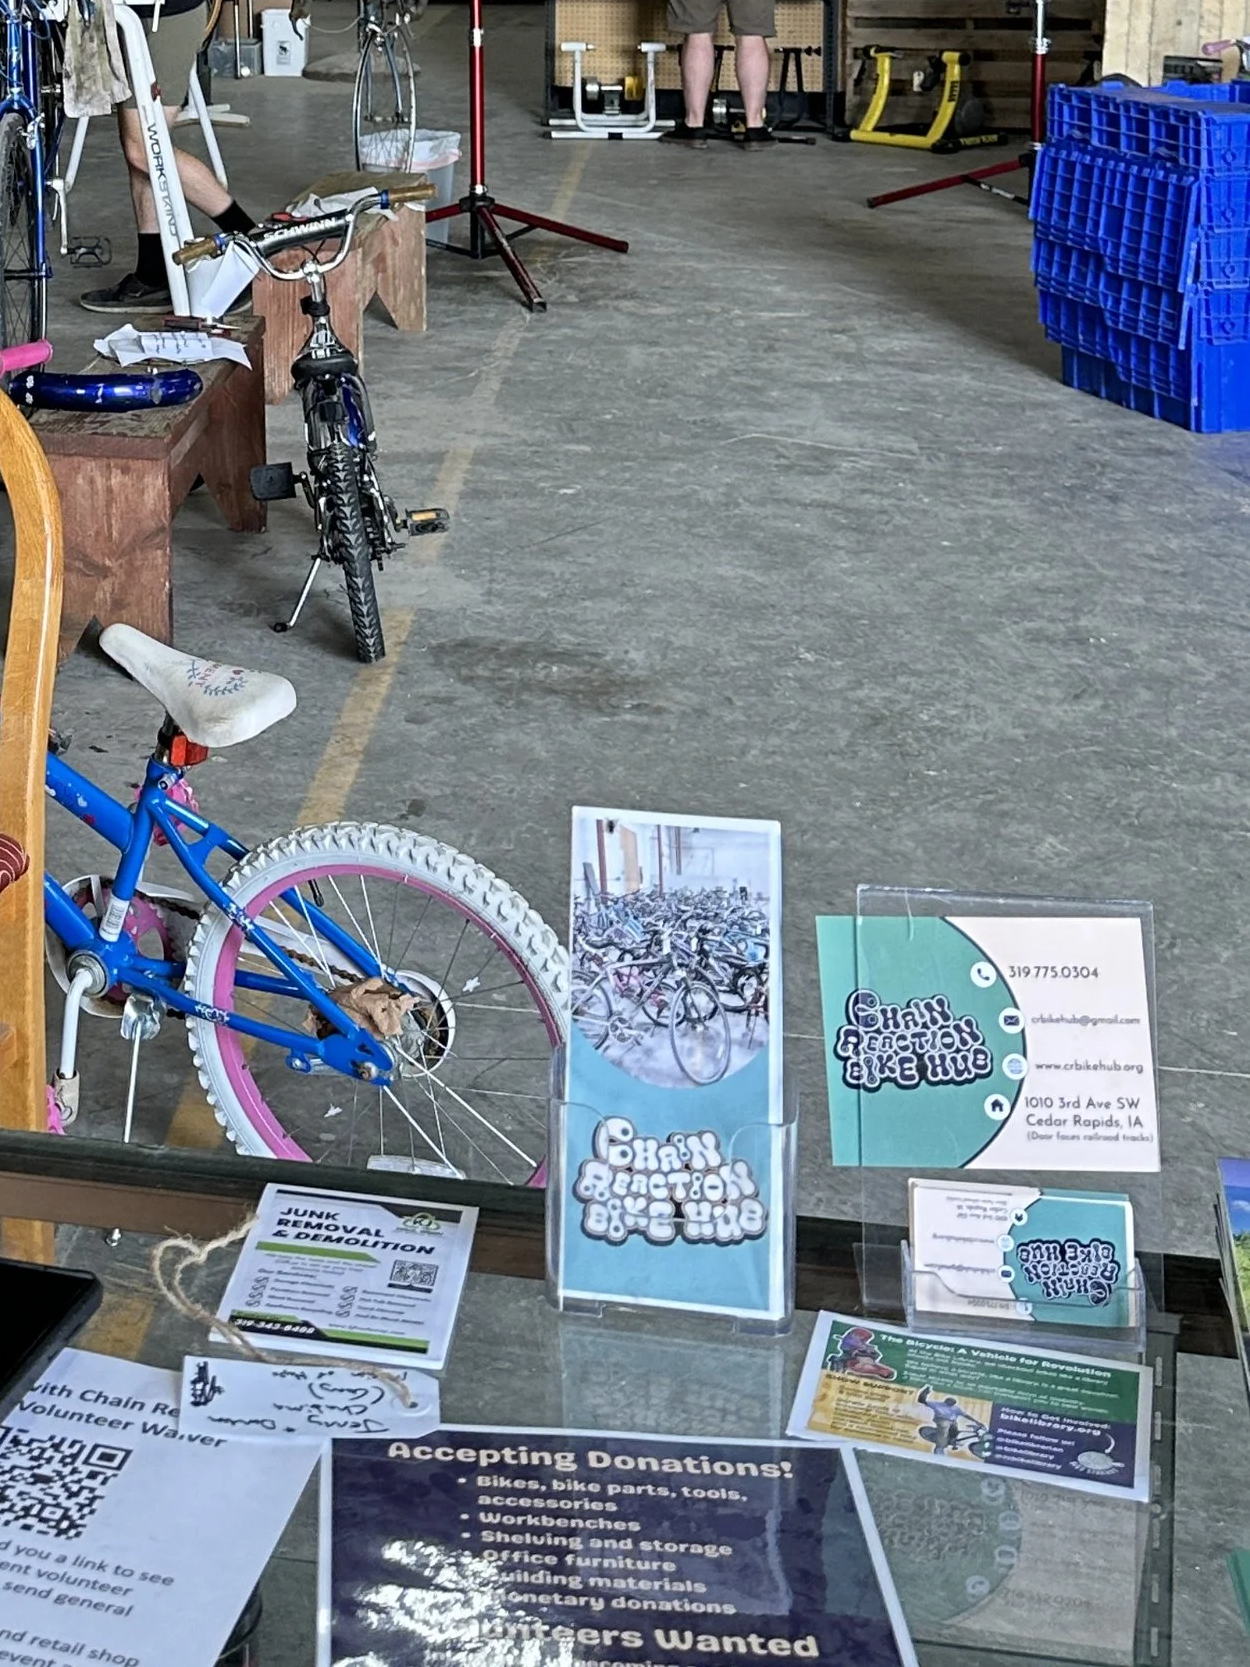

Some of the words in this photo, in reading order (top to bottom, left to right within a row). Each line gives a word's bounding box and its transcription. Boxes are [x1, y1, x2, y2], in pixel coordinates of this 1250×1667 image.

[264, 217, 337, 240] SCHWINN
[847, 989, 954, 1032] CHAIN
[836, 1016, 984, 1058] REACTION
[845, 1052, 919, 1088] BIKE
[924, 1046, 992, 1081] HUB
[1035, 1058, 1144, 1074] www.crbikehub.org
[1024, 1096, 1054, 1109] 1010
[1058, 1096, 1081, 1109] 3rd
[1085, 1096, 1112, 1110] Ave
[1116, 1096, 1141, 1110] SW
[1026, 1114, 1068, 1127] Cedar
[1073, 1114, 1123, 1130] Rapids,
[1128, 1115, 1144, 1128] IA
[279, 1206, 341, 1222] JUNK
[276, 1218, 385, 1239] REMOVAL
[272, 1230, 290, 1239] &
[299, 1232, 435, 1255] DEMOLITION
[1019, 1356, 1038, 1366] for
[79, 1387, 145, 1413] Chain
[18, 1399, 134, 1432] Volunteer
[1000, 1412, 1102, 1436] bikelibrary.org
[387, 1440, 577, 1472] Accepting
[587, 1450, 794, 1480] Donations!
[476, 1474, 548, 1493] Bikes,
[552, 1477, 602, 1493] bike
[607, 1481, 677, 1499] parts,
[681, 1486, 749, 1503] tools,
[477, 1493, 618, 1512] accessories
[479, 1511, 641, 1532] Workbenches
[480, 1530, 584, 1551] Shelving
[588, 1535, 633, 1551] and
[638, 1538, 733, 1558] storage
[14, 1545, 52, 1564] you
[53, 1552, 67, 1565] a
[71, 1554, 109, 1574] link
[113, 1564, 135, 1578] to
[138, 1570, 175, 1587] see
[481, 1548, 558, 1568] Office
[564, 1553, 678, 1573] furniture
[36, 1567, 135, 1598] volunteer
[494, 1569, 584, 1590] uilding
[588, 1575, 708, 1594] materials
[2, 1578, 52, 1600] send
[53, 1589, 135, 1618] general
[610, 1596, 737, 1616] donations
[29, 1631, 85, 1657] retail
[87, 1645, 140, 1667] shop
[653, 1625, 820, 1659] Wanted
